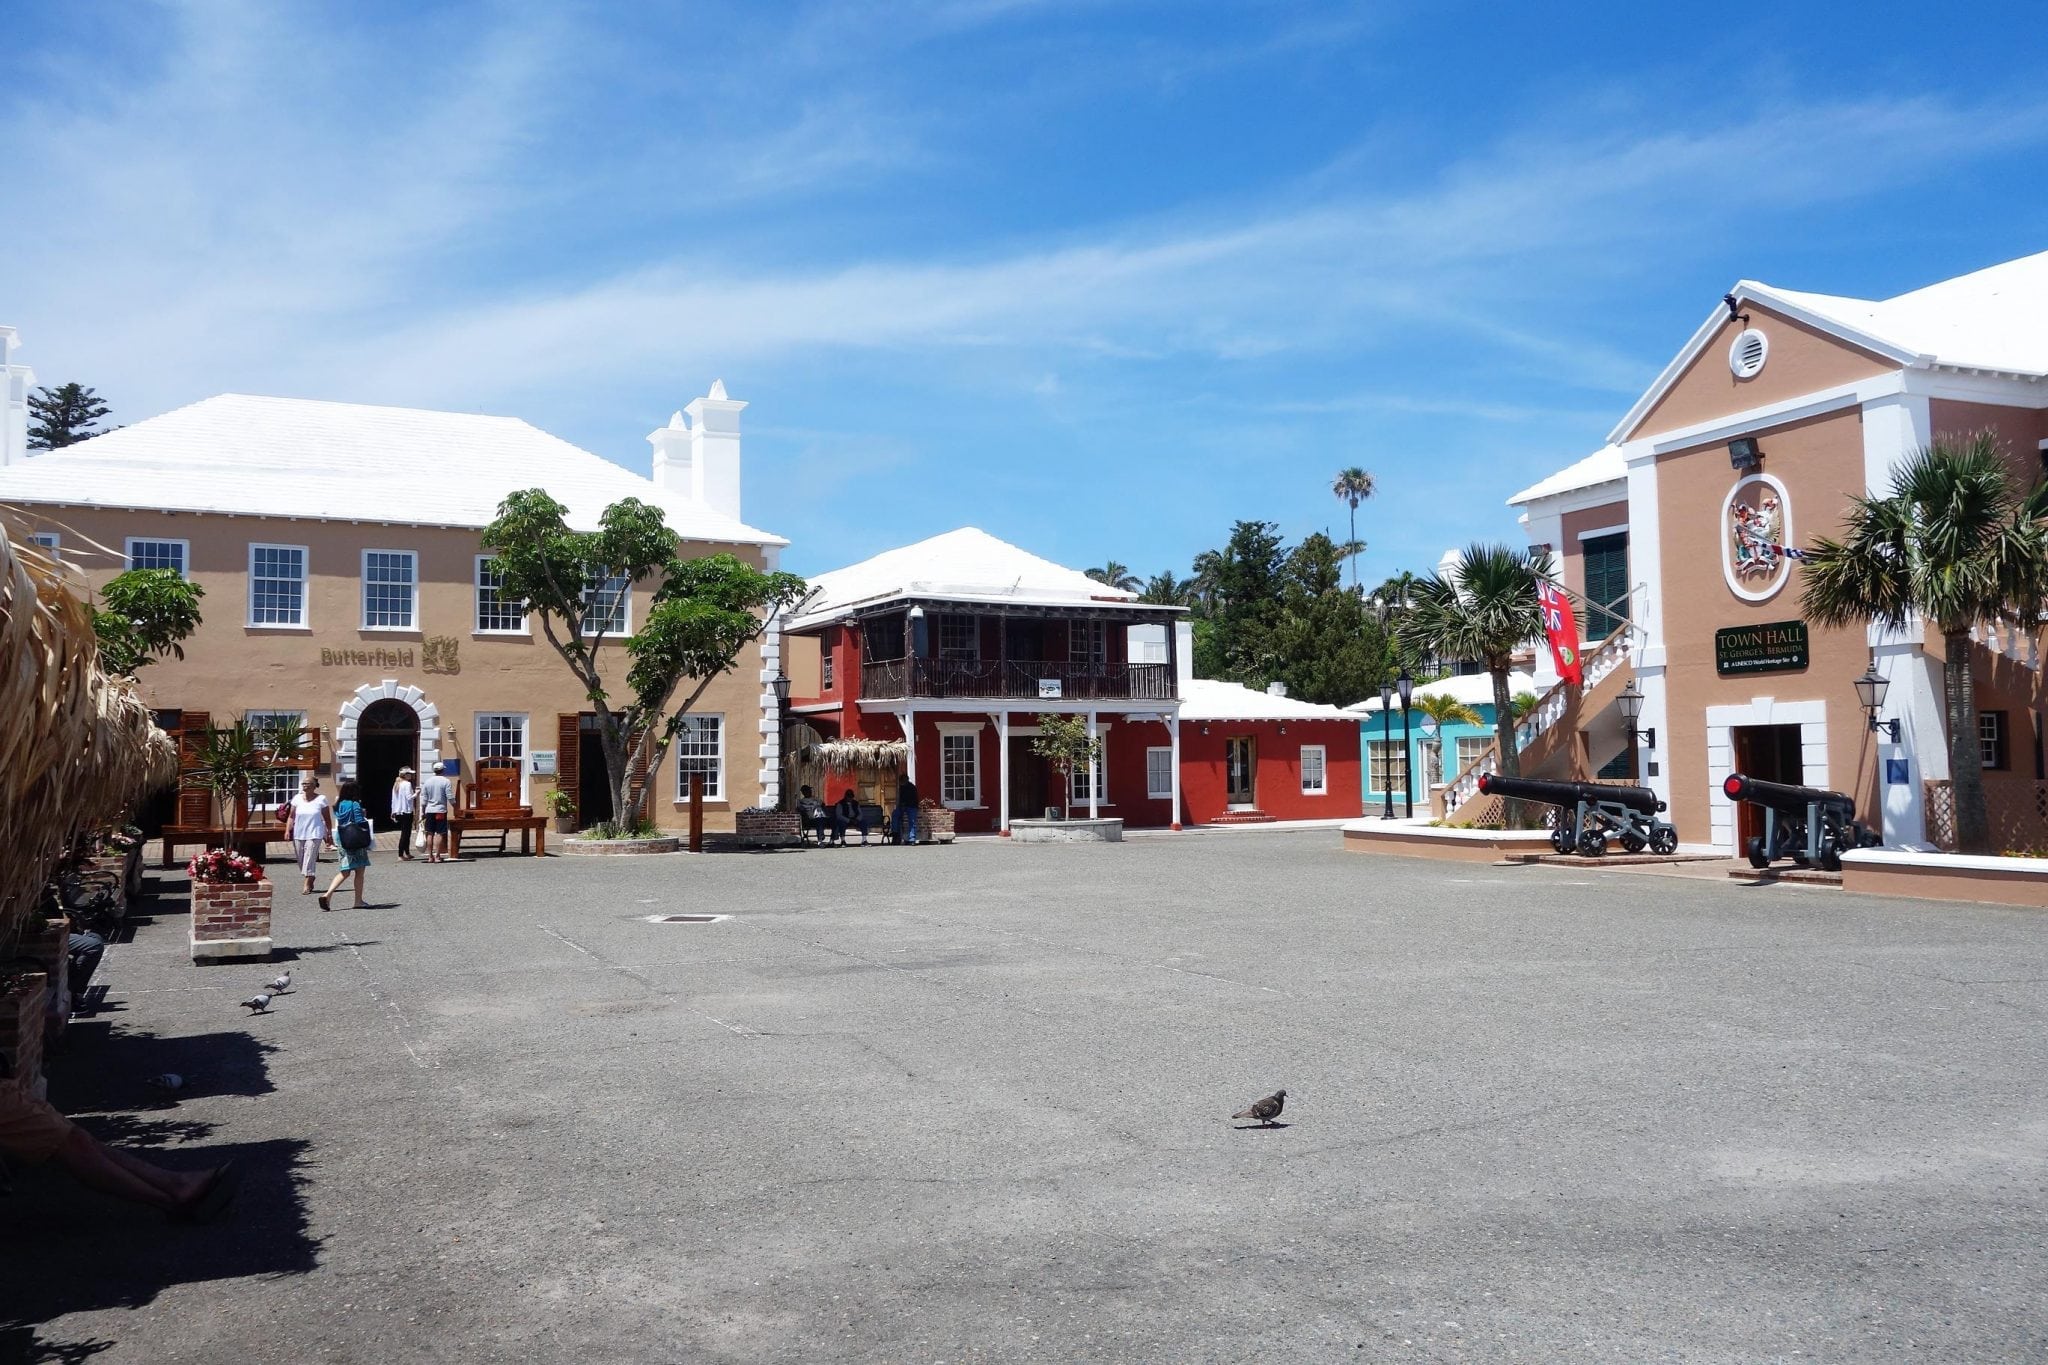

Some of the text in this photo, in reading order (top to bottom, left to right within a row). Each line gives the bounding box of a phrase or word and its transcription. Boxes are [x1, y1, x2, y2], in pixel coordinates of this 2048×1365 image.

[1718, 628, 1803, 649] TOWN HALL
[320, 647, 414, 668] Butterfield
[1767, 645, 1803, 655] BERMUDA
